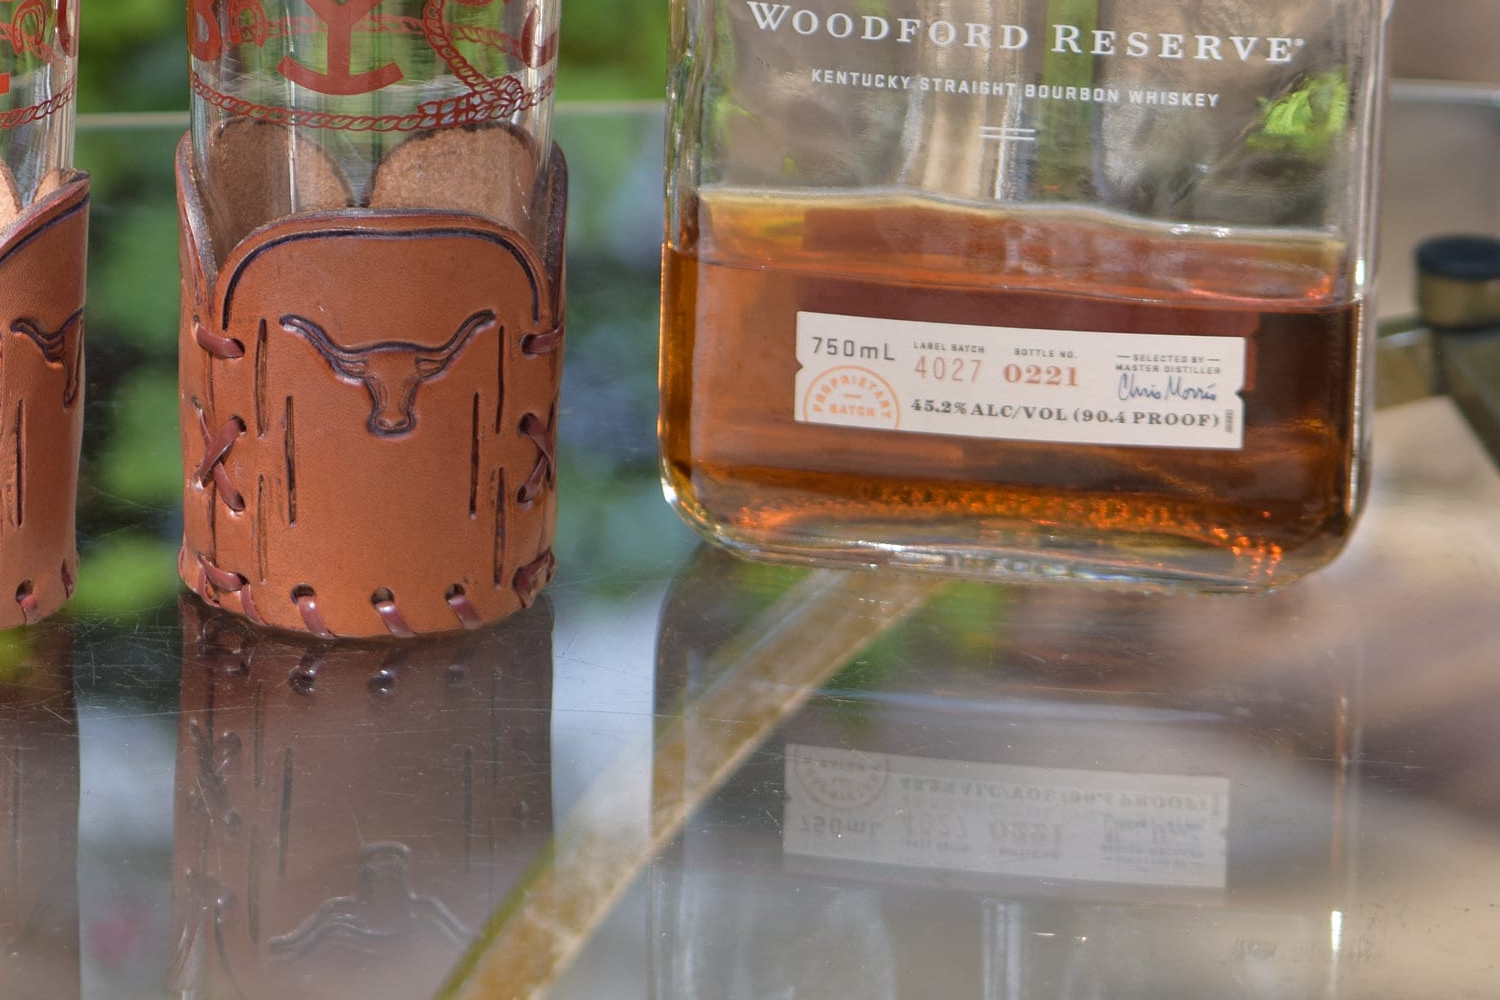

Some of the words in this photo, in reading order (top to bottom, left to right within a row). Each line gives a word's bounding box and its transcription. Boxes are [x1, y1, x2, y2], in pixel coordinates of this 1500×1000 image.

[746, 1, 1029, 50] WOODFORD
[811, 68, 911, 90] KENTUCKY
[920, 77, 1017, 98] STRAIGHT
[1025, 83, 1119, 103] BOURBON
[1129, 90, 1220, 108] WHISKEY
[811, 336, 896, 361] 750mL
[913, 341, 947, 351] LABEL
[950, 343, 985, 354] BATCH
[1014, 348, 1054, 358] BOTTLE
[1132, 353, 1188, 363] SELECTED
[914, 355, 983, 382] 4027
[1002, 364, 1079, 387] 0221
[1115, 363, 1160, 373] MASTER
[1164, 365, 1221, 375] DISTILLER
[829, 404, 876, 417] BATCH
[910, 398, 967, 415] 45.2%
[969, 402, 1068, 421] ALC/VOL
[1132, 410, 1220, 427] PROOF)
